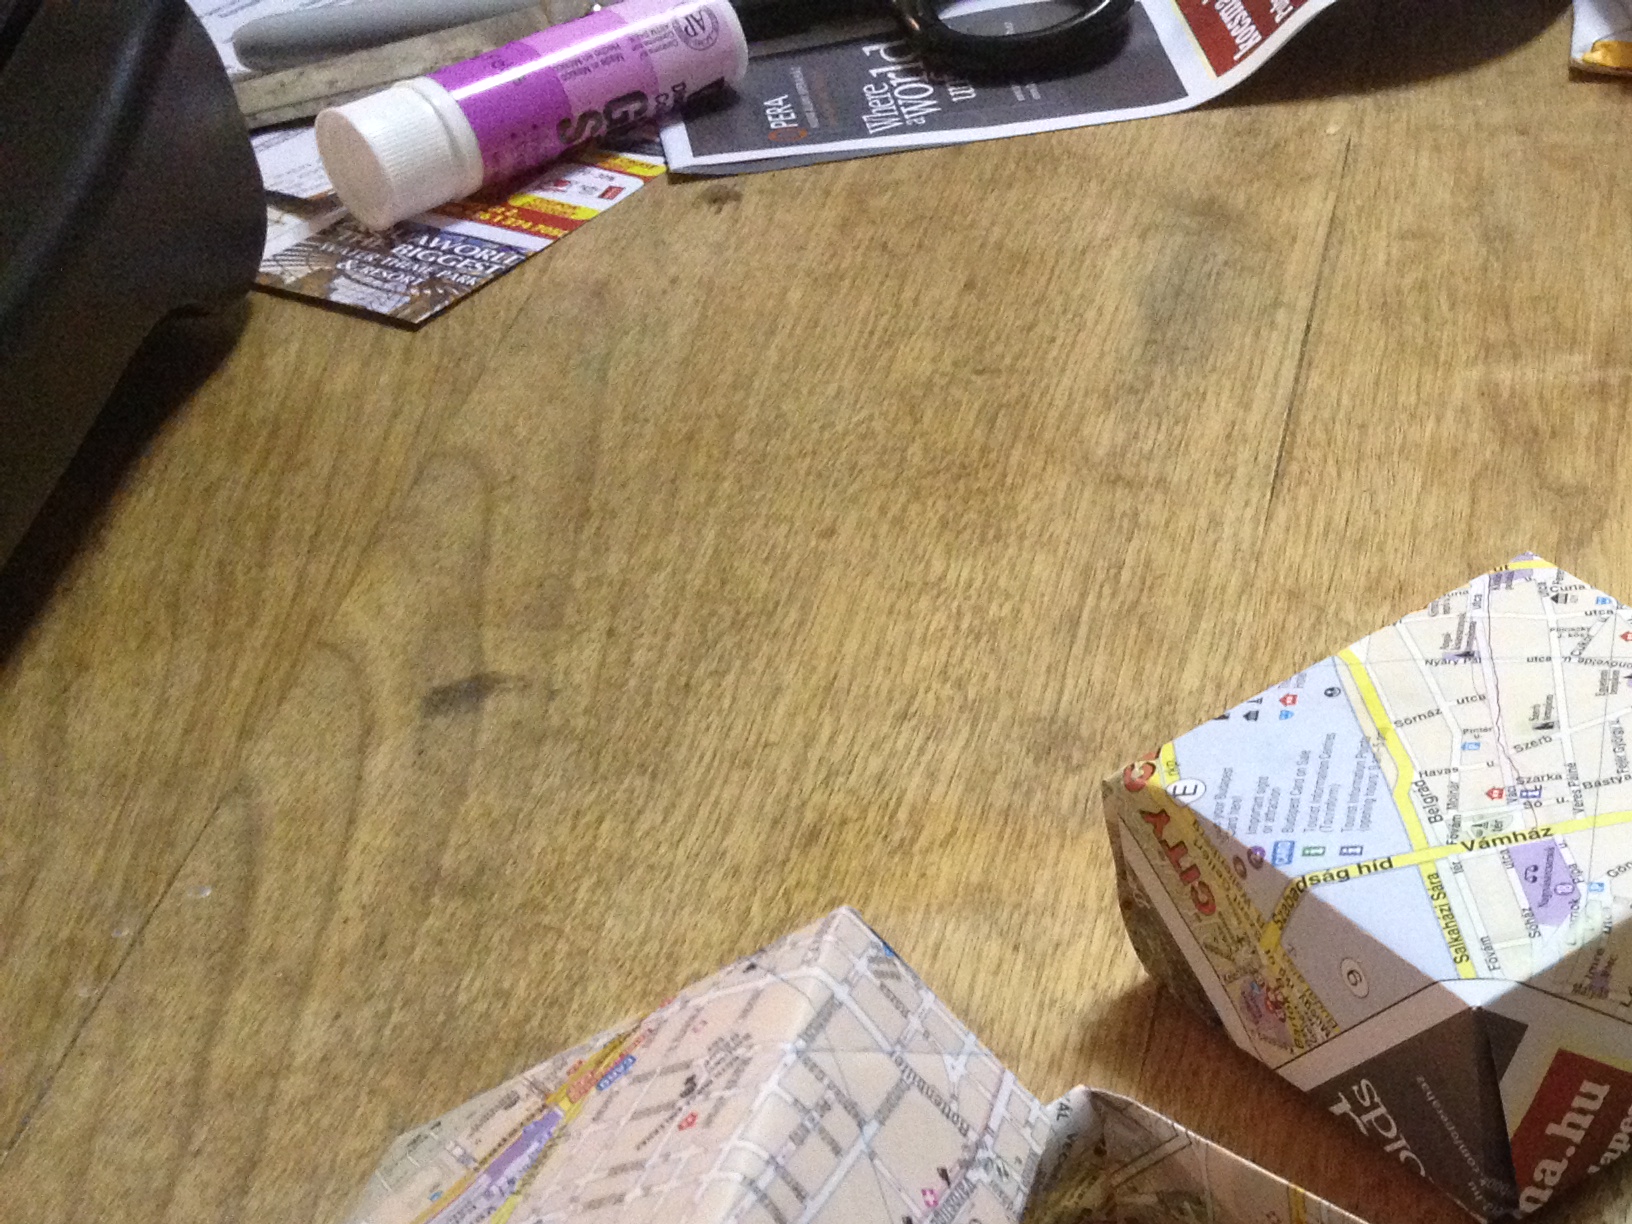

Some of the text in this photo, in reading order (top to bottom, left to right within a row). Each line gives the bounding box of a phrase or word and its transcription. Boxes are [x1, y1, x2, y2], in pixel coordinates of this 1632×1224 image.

[862, 82, 903, 135] Where
[392, 243, 502, 275] BIGGEST
[436, 270, 478, 287] PARK
[1513, 735, 1553, 753] Szerb
[1418, 766, 1460, 781] Havas
[1460, 825, 1554, 853] Vámház
[1139, 808, 1217, 917] CITY
[1271, 856, 1395, 932] Szabadság híd
